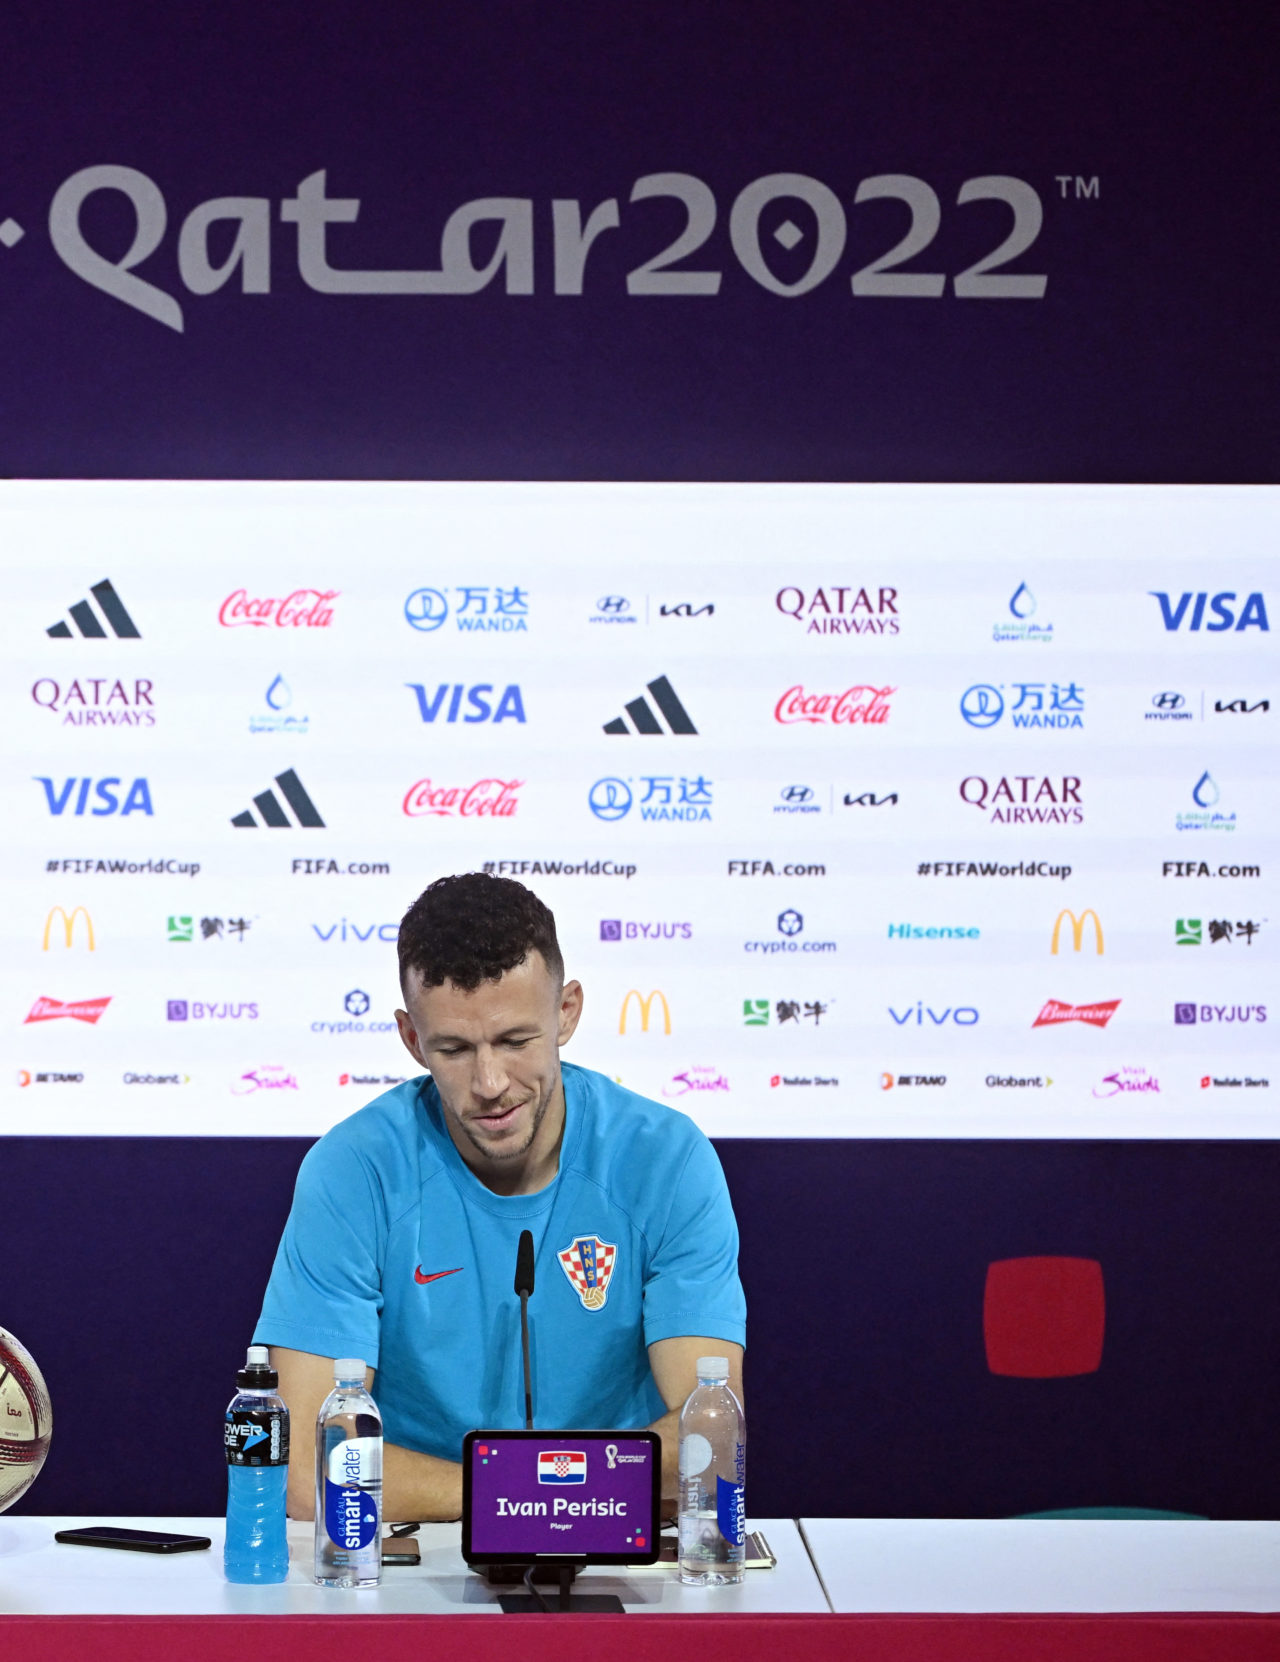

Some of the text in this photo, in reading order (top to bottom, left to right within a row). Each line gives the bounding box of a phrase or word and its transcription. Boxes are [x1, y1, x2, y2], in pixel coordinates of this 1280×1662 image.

[456, 586, 528, 615] 万达
[775, 586, 898, 618] QATAR
[1148, 591, 1270, 632] VISA
[457, 617, 527, 631] WANDA
[808, 618, 900, 634] AIRWAYS
[31, 678, 154, 710] QATAR
[1011, 682, 1084, 711] 万达
[405, 683, 527, 724] VISA
[64, 711, 155, 725] AIRWAYS
[1012, 712, 1084, 728] WANDA
[32, 776, 154, 816] VISA
[640, 775, 712, 804] 万达
[959, 776, 1082, 807] QATAR
[640, 805, 712, 821] WANDA
[991, 807, 1083, 824] AIRWAYS
[46, 859, 200, 877] #FIFAWorldCup
[292, 858, 390, 874] FIFA.com
[482, 860, 636, 879] #FIFAWorldCup
[728, 860, 826, 876] FIFA.com
[917, 861, 1072, 880] #FIFAWorldCup
[1162, 861, 1260, 877] FIFA.com
[200, 916, 251, 942] 蒙牛
[626, 922, 692, 939] BYJU'S
[888, 923, 980, 939] Hisense
[1208, 918, 1260, 946] 蒙牛
[744, 940, 836, 953] crypto.com
[193, 1002, 258, 1019] BYJU'S
[776, 1000, 827, 1026] 蒙牛
[888, 1001, 979, 1025] vivo
[1039, 1002, 1114, 1024] Budweiser
[1200, 1005, 1267, 1023] BYJU'S
[985, 1075, 1044, 1088] Globant
[224, 1423, 263, 1437] OWER
[224, 1434, 237, 1446] DE
[496, 1498, 627, 1516] Ivan Perisic
[550, 1523, 573, 1532] Player
